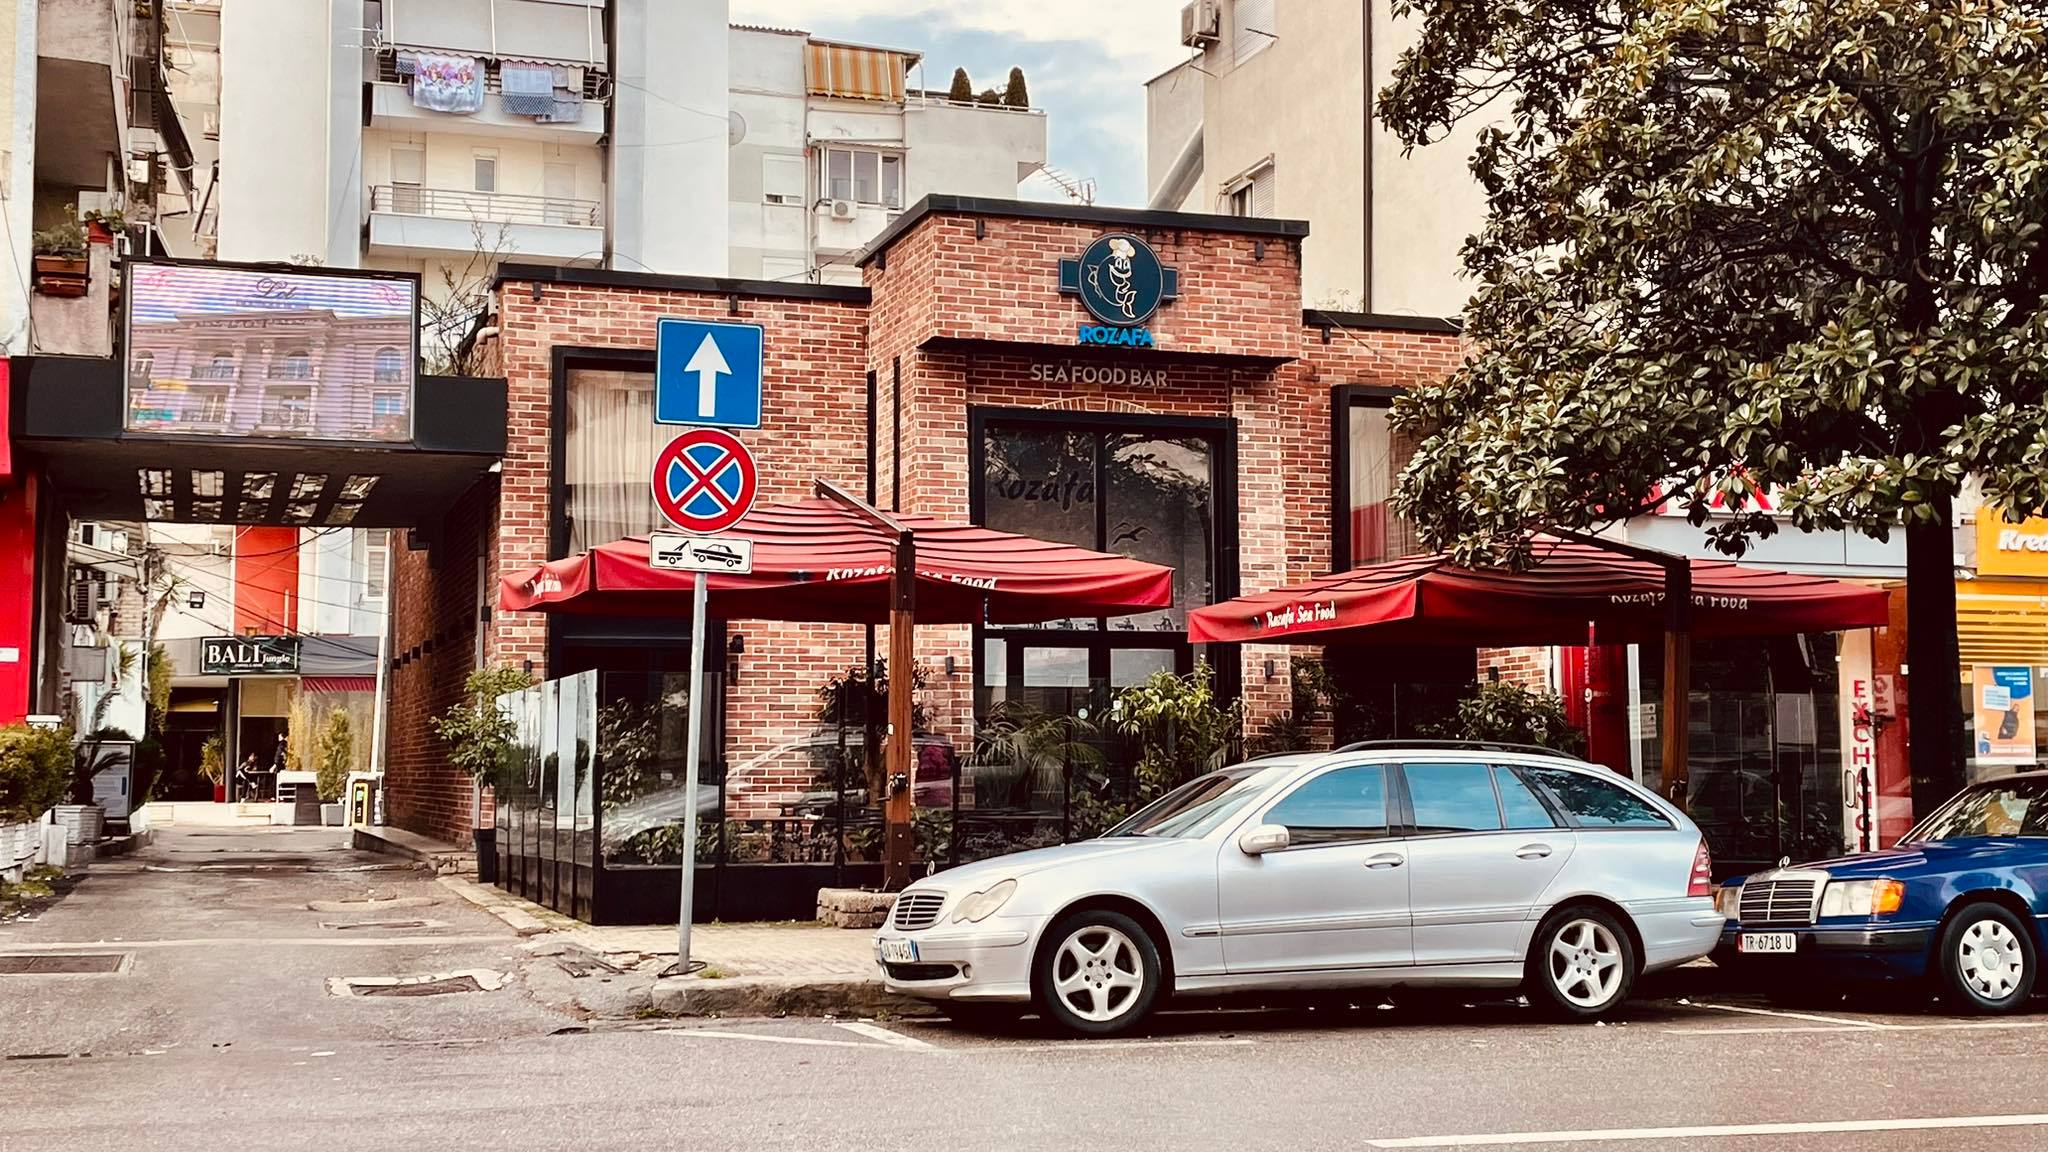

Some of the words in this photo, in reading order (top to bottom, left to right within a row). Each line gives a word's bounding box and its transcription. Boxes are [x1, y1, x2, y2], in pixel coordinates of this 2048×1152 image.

[1078, 325, 1154, 346] ROZAFA
[1030, 364, 1068, 383] SEA
[1071, 366, 1126, 384] FOOD
[1130, 368, 1168, 387] BAR
[1297, 605, 1314, 624] Sea
[1315, 600, 1336, 621] Food
[208, 644, 260, 664] BALI
[262, 652, 291, 665] Jungle
